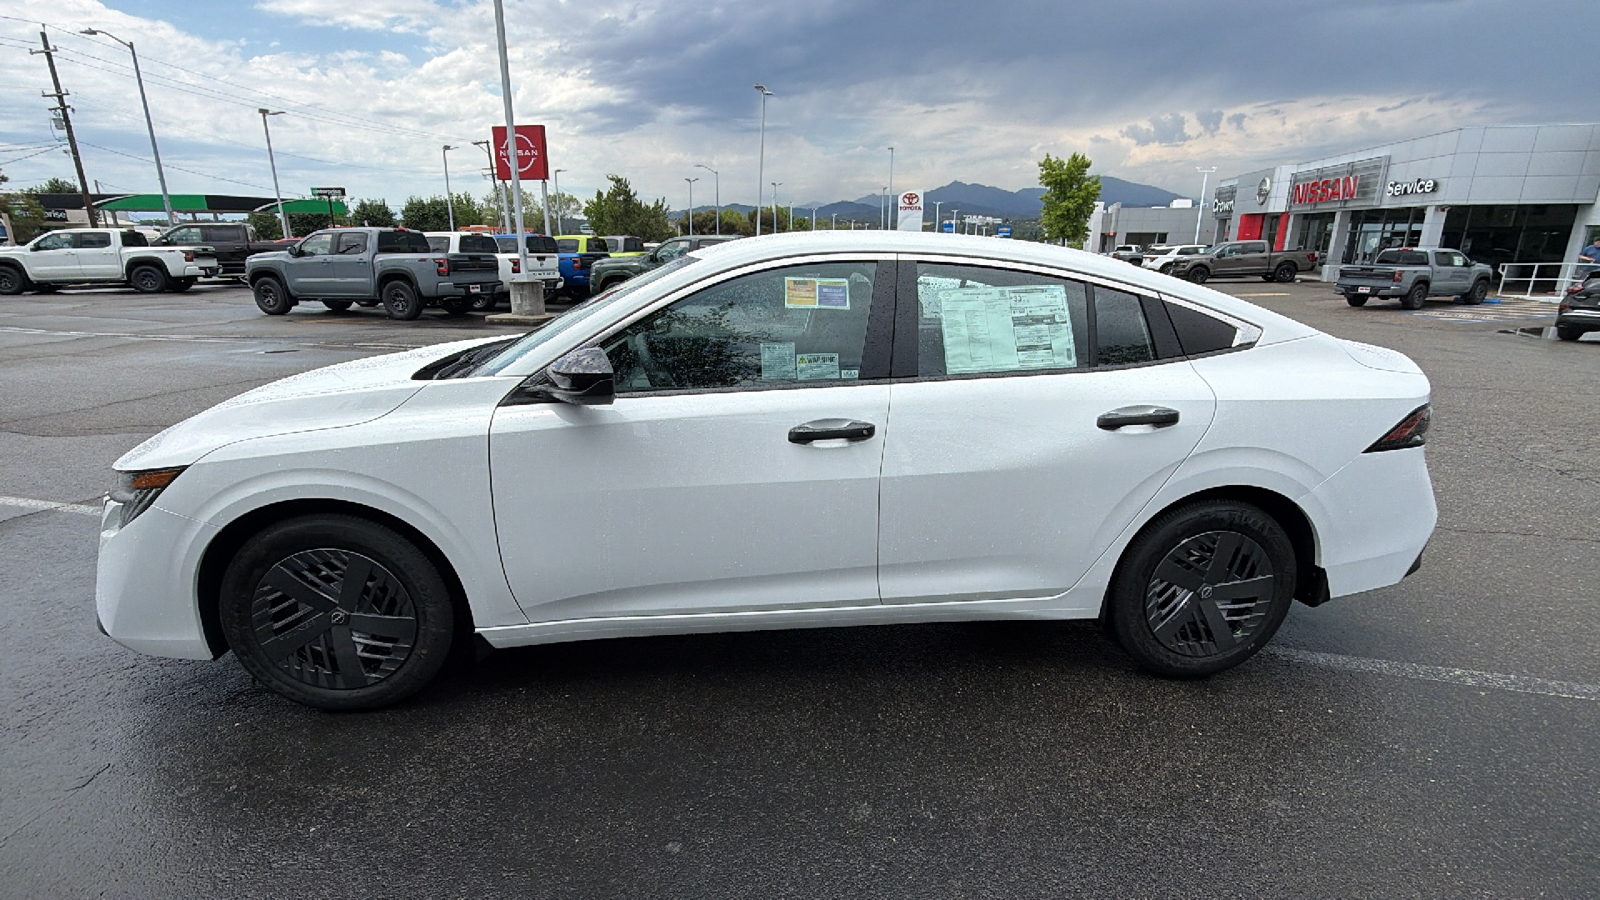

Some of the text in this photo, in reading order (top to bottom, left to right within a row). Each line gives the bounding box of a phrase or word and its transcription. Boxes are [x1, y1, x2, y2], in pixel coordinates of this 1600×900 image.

[1292, 175, 1359, 204] NISSAN
[1386, 179, 1434, 197] Service
[1212, 199, 1234, 213] Crown
